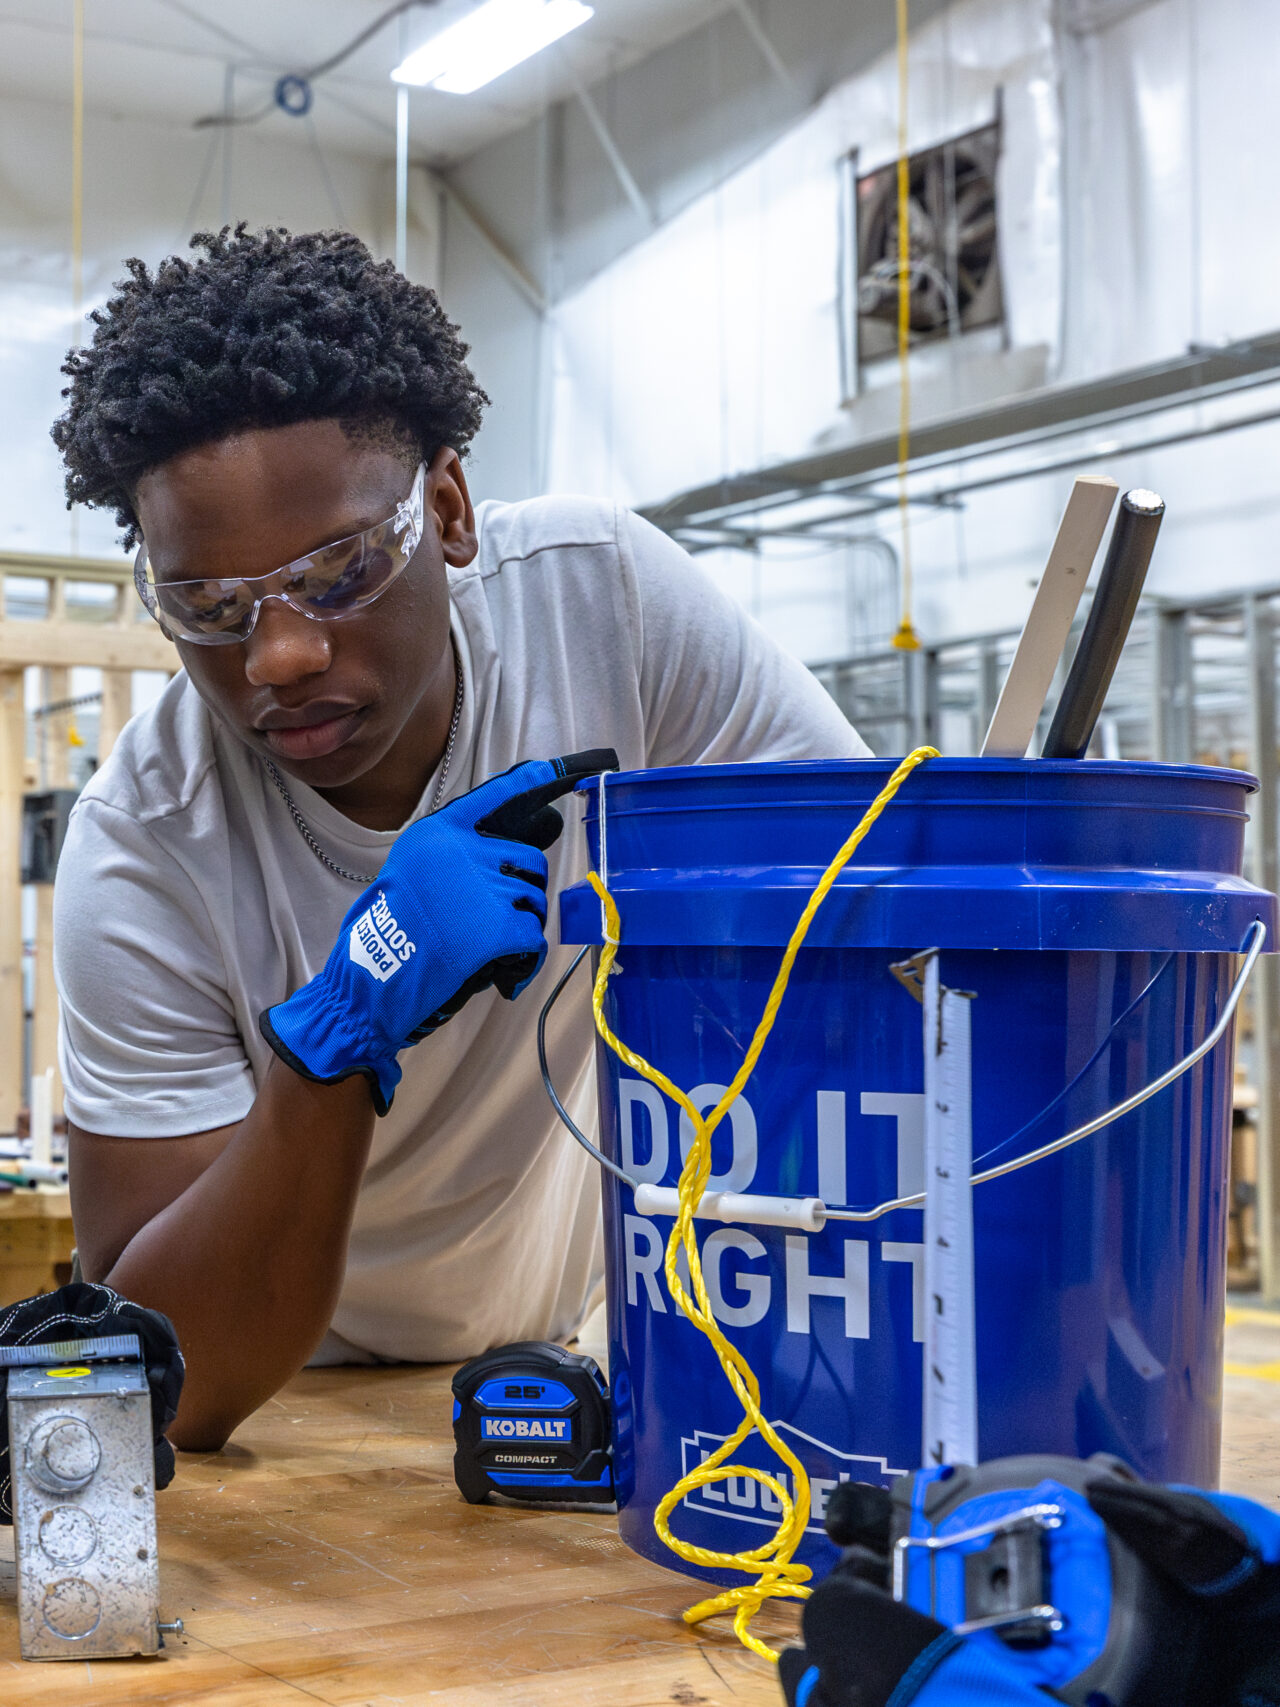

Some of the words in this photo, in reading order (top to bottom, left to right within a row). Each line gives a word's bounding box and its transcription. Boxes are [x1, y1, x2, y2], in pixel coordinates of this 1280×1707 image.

[356, 918, 394, 973] PROJECT
[619, 1078, 758, 1195] DO
[817, 1090, 926, 1210] IT
[486, 1419, 566, 1438] KOBALT
[494, 1454, 558, 1464] COMPACT
[700, 1450, 850, 1521] LOWE'
